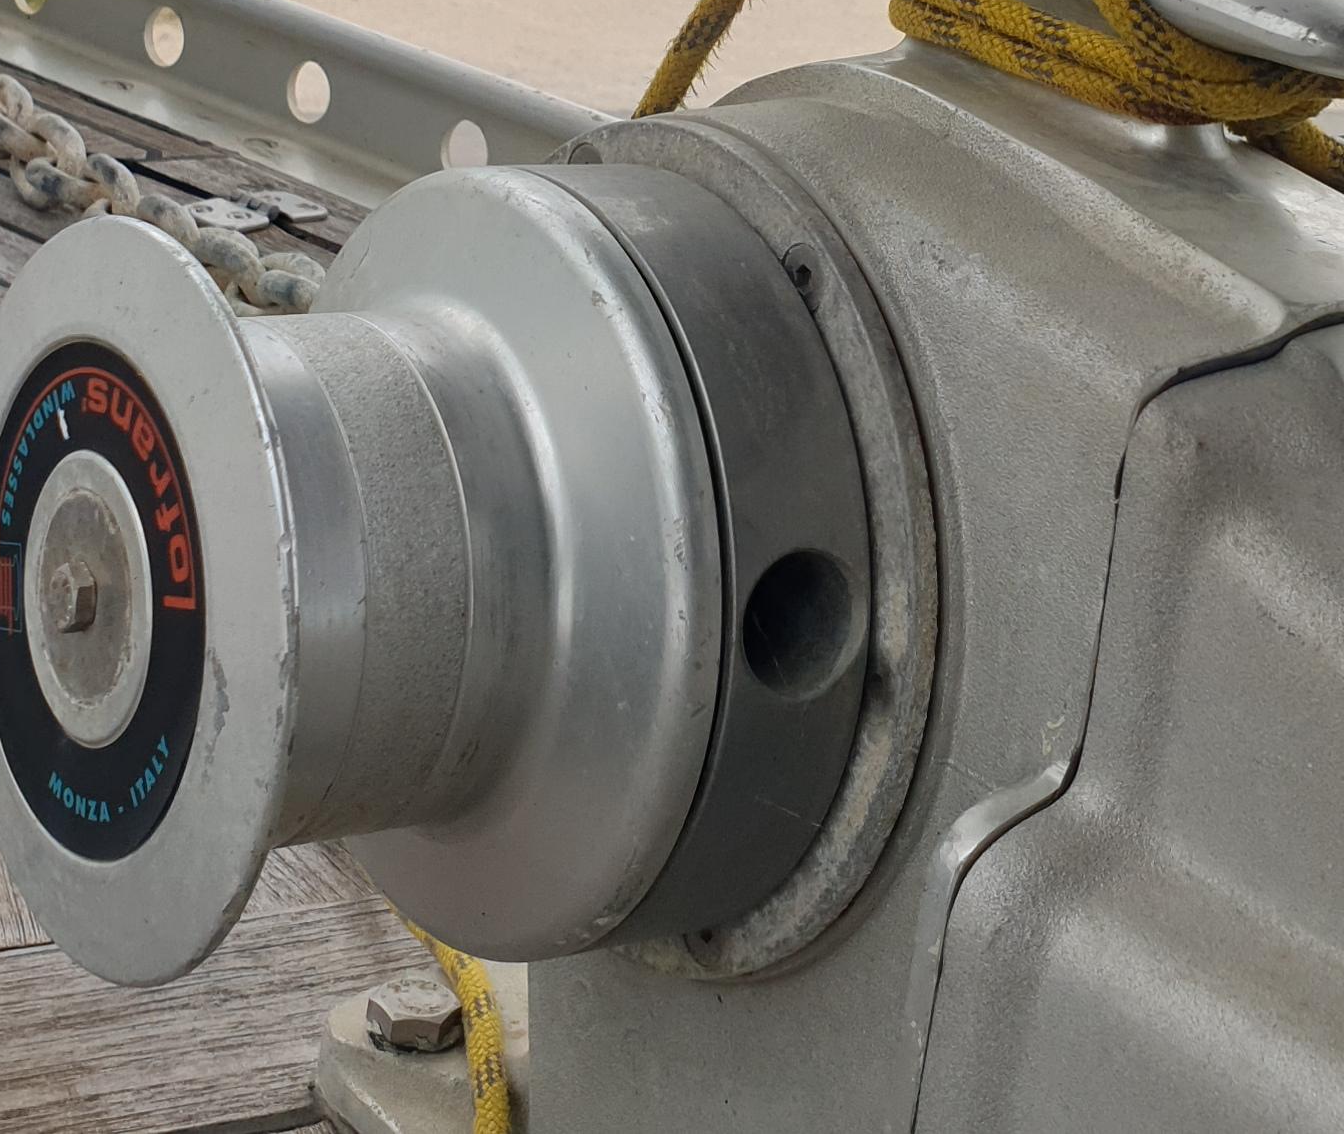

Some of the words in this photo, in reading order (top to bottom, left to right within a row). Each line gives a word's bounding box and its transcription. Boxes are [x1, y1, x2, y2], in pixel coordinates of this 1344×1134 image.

[1, 379, 77, 527] WINDLASSES
[48, 770, 112, 823] MONZA
[129, 734, 170, 808] ITALY
